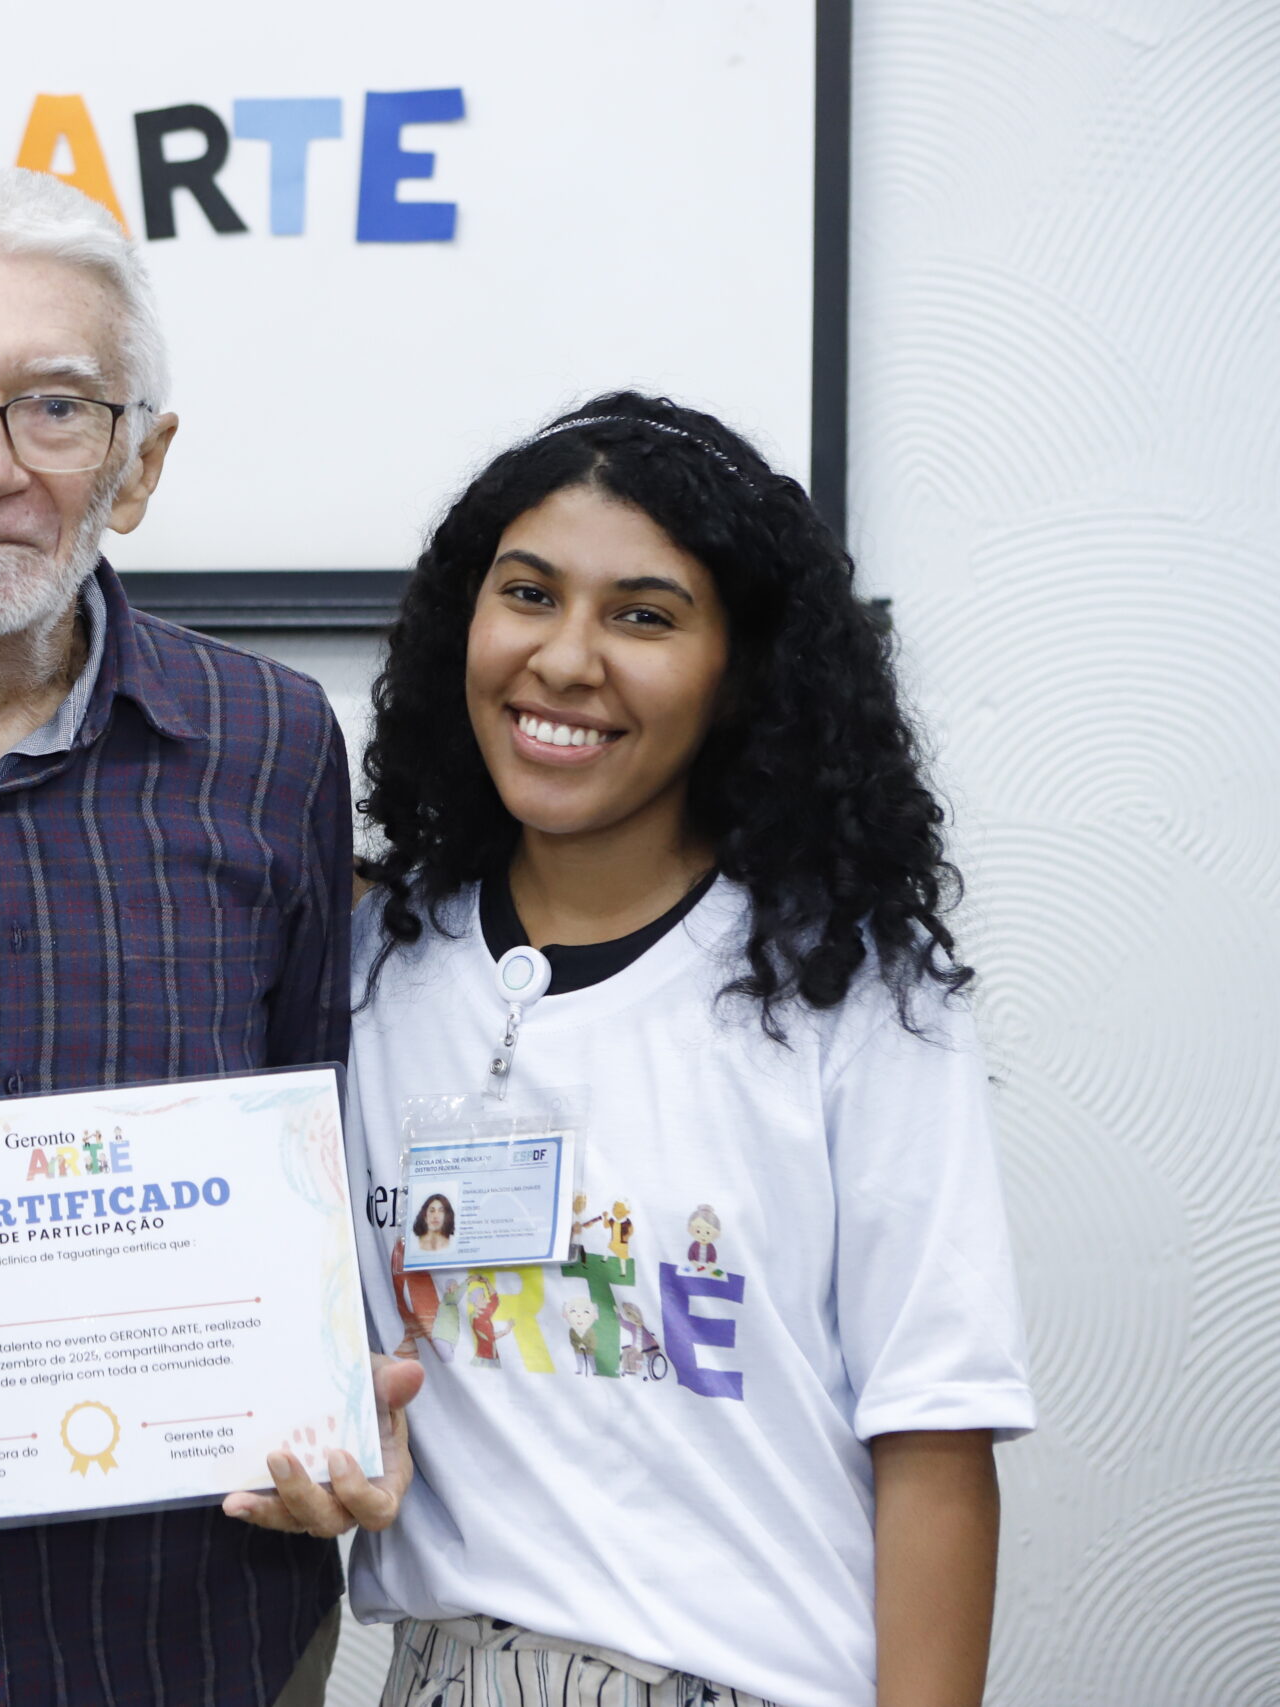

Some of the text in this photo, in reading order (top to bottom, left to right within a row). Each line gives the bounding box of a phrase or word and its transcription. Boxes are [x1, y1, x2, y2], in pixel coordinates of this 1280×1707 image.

[15, 87, 466, 243] ARTE
[5, 1130, 75, 1150] Geronto
[26, 1140, 133, 1181] ARTE
[0, 1216, 165, 1245] DE PARTICIPAÇÃO
[40, 1250, 54, 1262] de
[57, 1244, 120, 1261] Taguatinga
[122, 1240, 167, 1255] certifica
[170, 1238, 191, 1251] que
[0, 1340, 43, 1354] talento
[45, 1338, 61, 1349] no
[64, 1332, 107, 1346] evento
[109, 1326, 168, 1341] GERONTO
[171, 1323, 202, 1335] ARTE,
[205, 1317, 261, 1332] realizado
[50, 1354, 66, 1366] de
[69, 1350, 102, 1363] 2025,
[104, 1340, 204, 1360] compartilhando
[207, 1338, 235, 1349] arte,
[19, 1377, 27, 1386] e
[30, 1370, 74, 1386] alegria
[77, 1369, 105, 1380] com
[108, 1363, 137, 1376] toda
[140, 1364, 149, 1374] a
[152, 1355, 233, 1372] comunidade.
[164, 1426, 234, 1443] Gerente da
[22, 1446, 39, 1459] do
[170, 1443, 235, 1460] Instituição
